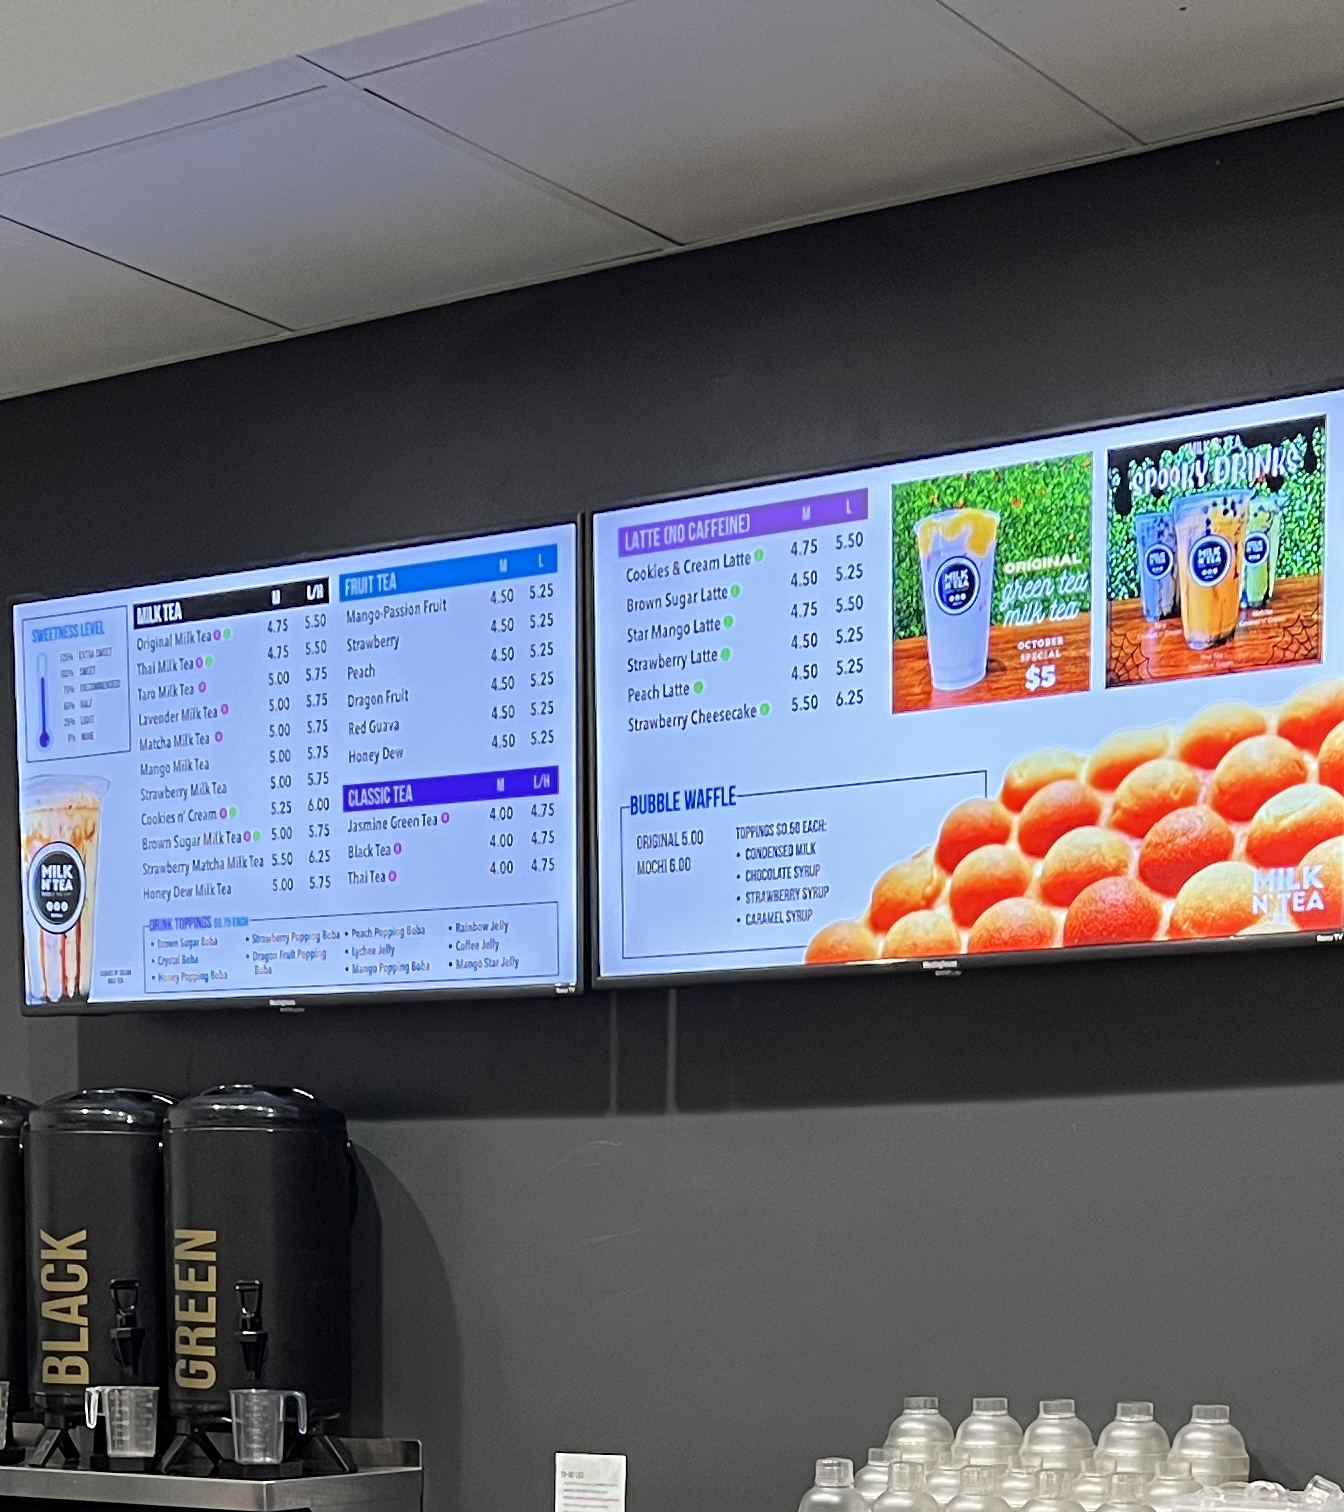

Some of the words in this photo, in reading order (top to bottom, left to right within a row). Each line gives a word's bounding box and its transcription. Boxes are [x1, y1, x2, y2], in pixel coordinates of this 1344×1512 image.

[1131, 457, 1208, 497] SPOOKY
[1213, 441, 1302, 486] DRINKS
[624, 527, 660, 550] LATTE
[663, 523, 685, 544] (NO
[688, 512, 750, 541] CAFFEINE)
[801, 505, 810, 521] M
[846, 498, 851, 514] L
[626, 563, 669, 582] Cookies
[683, 558, 719, 574] Cream
[723, 552, 751, 568] Latte
[790, 538, 817, 555] 4.75
[835, 531, 863, 550] 5.50
[1004, 551, 1082, 575] ORIGINAL
[344, 574, 373, 596] FRUIT
[376, 571, 396, 591] TEA
[499, 557, 507, 572] M
[538, 553, 543, 567] L
[626, 597, 661, 612] Brown
[665, 591, 698, 609] Sugar
[700, 586, 727, 602] Latte
[790, 569, 817, 587] 4.50
[835, 563, 863, 581] 5.25
[999, 571, 1055, 611] green
[1057, 566, 1089, 595] tea
[136, 604, 162, 625] MILK
[162, 601, 182, 621] TEA
[346, 601, 421, 625] Mango-Passion
[423, 598, 446, 613] Fruit
[490, 588, 513, 603] 4.50
[529, 582, 553, 599] 5.25
[627, 627, 648, 643] Star
[651, 623, 690, 640] Mango
[693, 618, 720, 633] Latte
[790, 600, 817, 618] 4.75
[835, 594, 863, 613] 5.50
[136, 633, 173, 652] Original
[174, 630, 195, 645] Milk
[196, 629, 211, 642] Tea
[267, 618, 288, 632] 4.75
[304, 613, 326, 629] 5.50
[346, 634, 399, 652] Strawberry
[490, 617, 514, 632] 4.50
[529, 612, 553, 628] 5.25
[627, 653, 687, 672] Strawberry
[690, 649, 717, 664] Latte
[790, 632, 817, 649] 4.50
[835, 625, 863, 644] 5.25
[1017, 635, 1064, 651] OCTOBER
[347, 662, 375, 679] Peach
[490, 646, 514, 661] 4.50
[529, 641, 553, 658] 5.25
[1020, 648, 1062, 662] SPECIAL
[347, 694, 383, 710] Dragon
[385, 687, 408, 703] Fruit
[490, 675, 514, 691] 4.50
[530, 670, 553, 687] 5.25
[627, 684, 659, 702] Peach
[662, 683, 689, 697] Latte
[791, 663, 817, 680] 4.50
[835, 657, 863, 675] 5.25
[1024, 661, 1056, 692] $5
[348, 720, 366, 735] Red
[368, 719, 399, 733] Guava
[491, 704, 515, 719] 4.50
[530, 700, 553, 716] 5.25
[628, 713, 688, 732] Strawberry
[690, 702, 756, 725] Cheesecake
[791, 694, 817, 711] 5.50
[835, 688, 863, 706] 6.25
[348, 749, 379, 765] Honey
[382, 746, 403, 759] Dew
[491, 733, 515, 748] 4.50
[530, 729, 554, 745] 5.25
[347, 786, 390, 807] CLASSIC
[392, 784, 413, 803] TEA
[496, 777, 504, 791] M
[630, 790, 680, 815] BUBBLE
[683, 785, 736, 810] WAFFLE
[140, 811, 175, 825] Cookies
[187, 808, 217, 822] Cream
[270, 800, 291, 815] 5.25
[307, 797, 329, 811] 6.00
[347, 816, 387, 832] Jasmine
[390, 815, 419, 829] Green
[421, 813, 437, 826] Tea
[489, 805, 513, 820] 4.00
[530, 802, 554, 817] 4.75
[141, 837, 171, 850] Brown
[173, 834, 200, 851] Sugar
[203, 830, 224, 845] Milk
[225, 830, 241, 843] Tea
[271, 826, 292, 840] 5.00
[308, 823, 329, 837] 5.75
[347, 843, 373, 858] Black
[374, 843, 390, 856] Tea
[489, 833, 513, 847] 4.00
[531, 829, 554, 844] 4.75
[636, 831, 679, 849] ORIGINAL
[681, 829, 703, 845] 5.00
[41, 863, 73, 881] MILK
[142, 860, 189, 876] Strawberry
[192, 856, 224, 871] Matcha
[227, 854, 247, 869] Milk
[248, 854, 263, 867] Tea
[271, 851, 292, 866] 5.50
[308, 849, 330, 863] 6.25
[347, 870, 368, 884] Thai
[369, 869, 385, 883] Tea
[489, 859, 513, 874] 4.00
[530, 857, 554, 871] 4.75
[636, 858, 667, 874] MOCHI
[669, 856, 690, 872] 6.00
[1254, 865, 1324, 893] MILK
[40, 1229, 89, 1385] BLACK
[174, 1229, 217, 1389] GREEN
